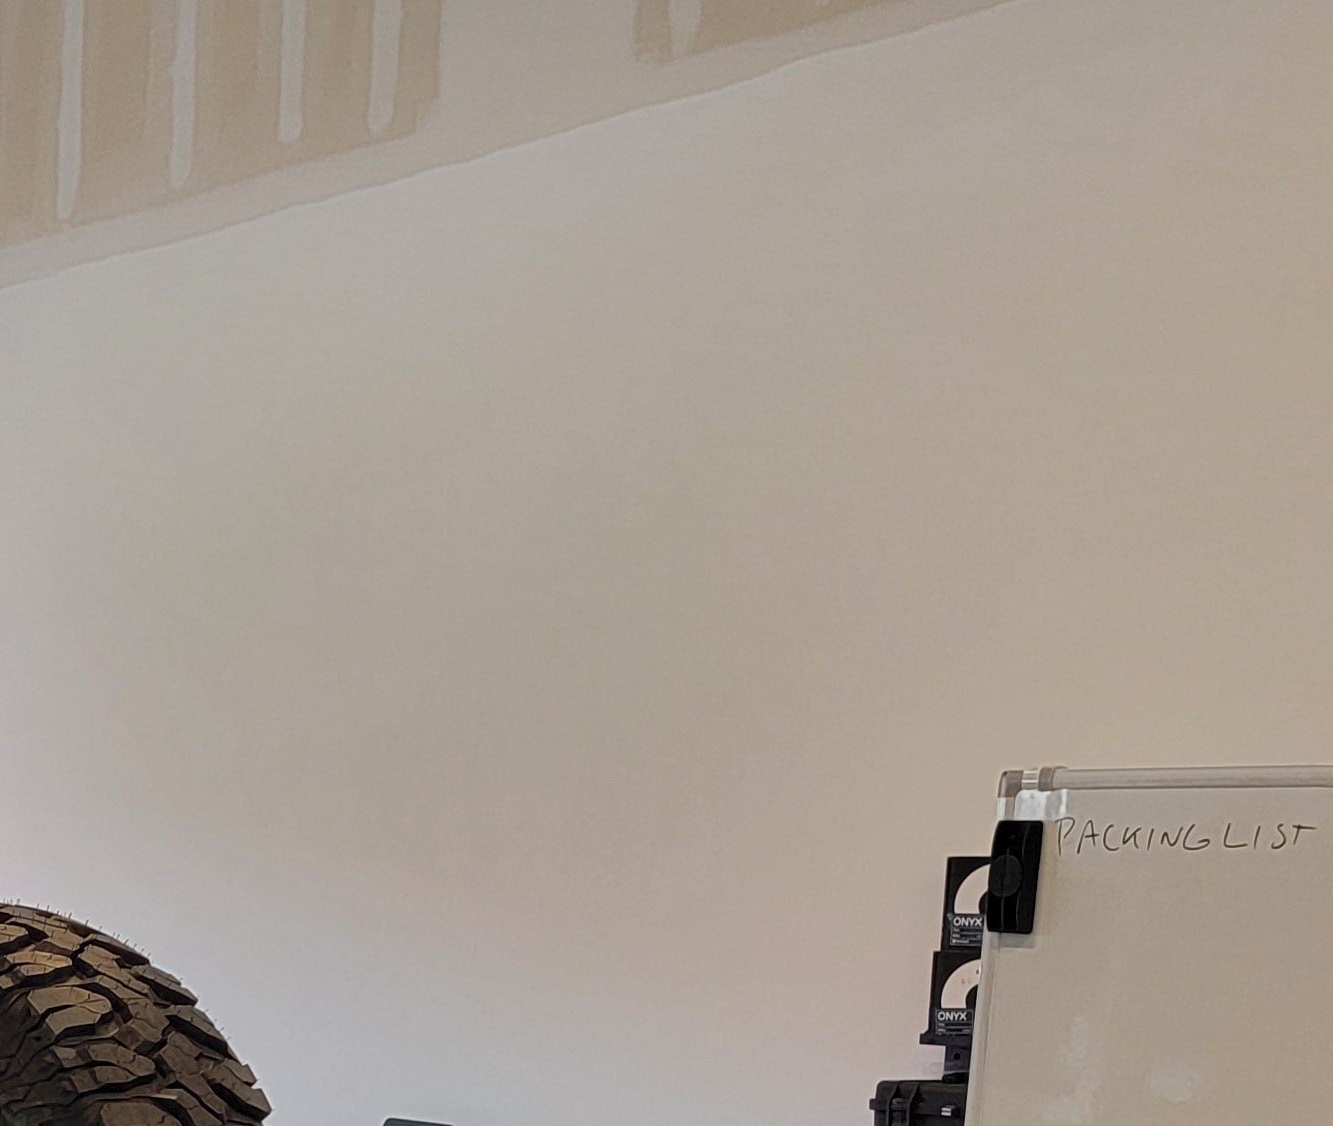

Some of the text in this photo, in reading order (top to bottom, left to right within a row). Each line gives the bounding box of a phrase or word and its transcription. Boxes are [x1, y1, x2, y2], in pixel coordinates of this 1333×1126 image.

[1055, 817, 1318, 856] PACKING LIST
[953, 916, 982, 927] ONYX
[937, 1011, 967, 1021] ONYX
